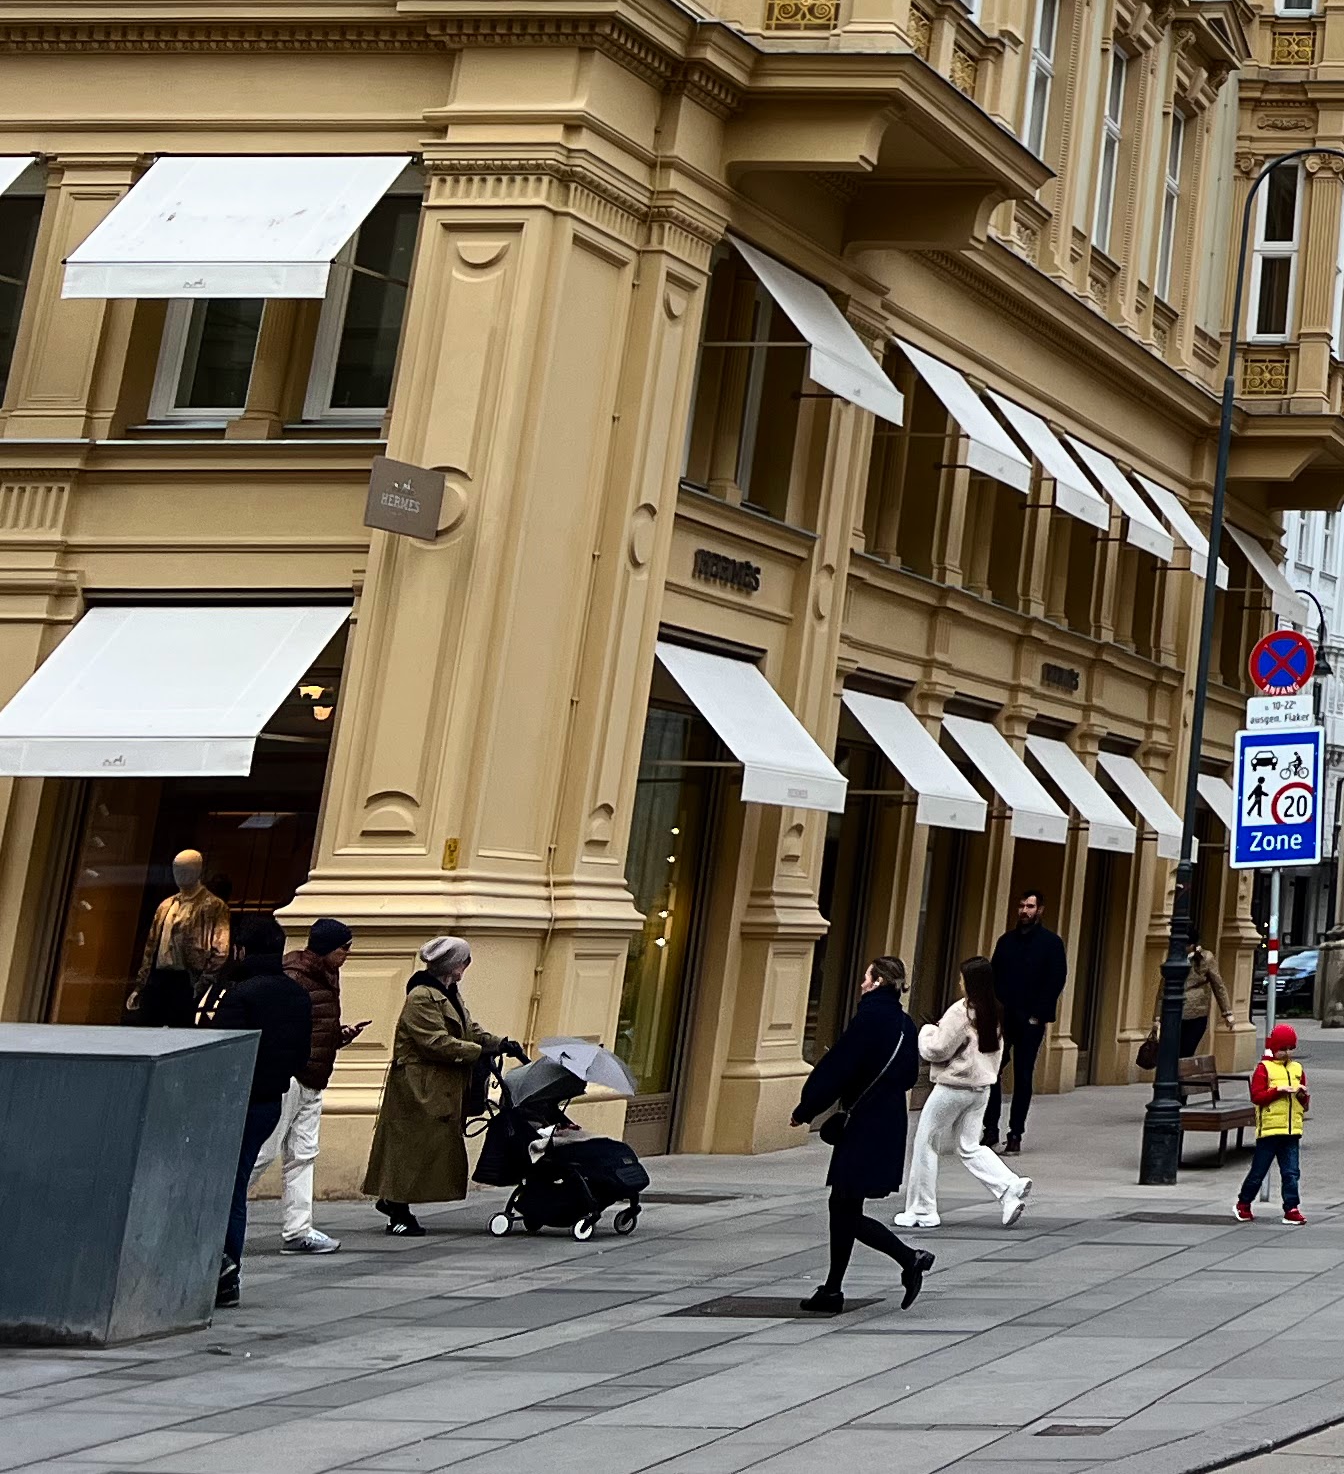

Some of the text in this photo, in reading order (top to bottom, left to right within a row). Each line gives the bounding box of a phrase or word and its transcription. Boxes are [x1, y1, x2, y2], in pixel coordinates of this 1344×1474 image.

[1263, 682, 1300, 695] ANFANG
[1284, 795, 1308, 817] 20
[1250, 831, 1303, 852] Zone
